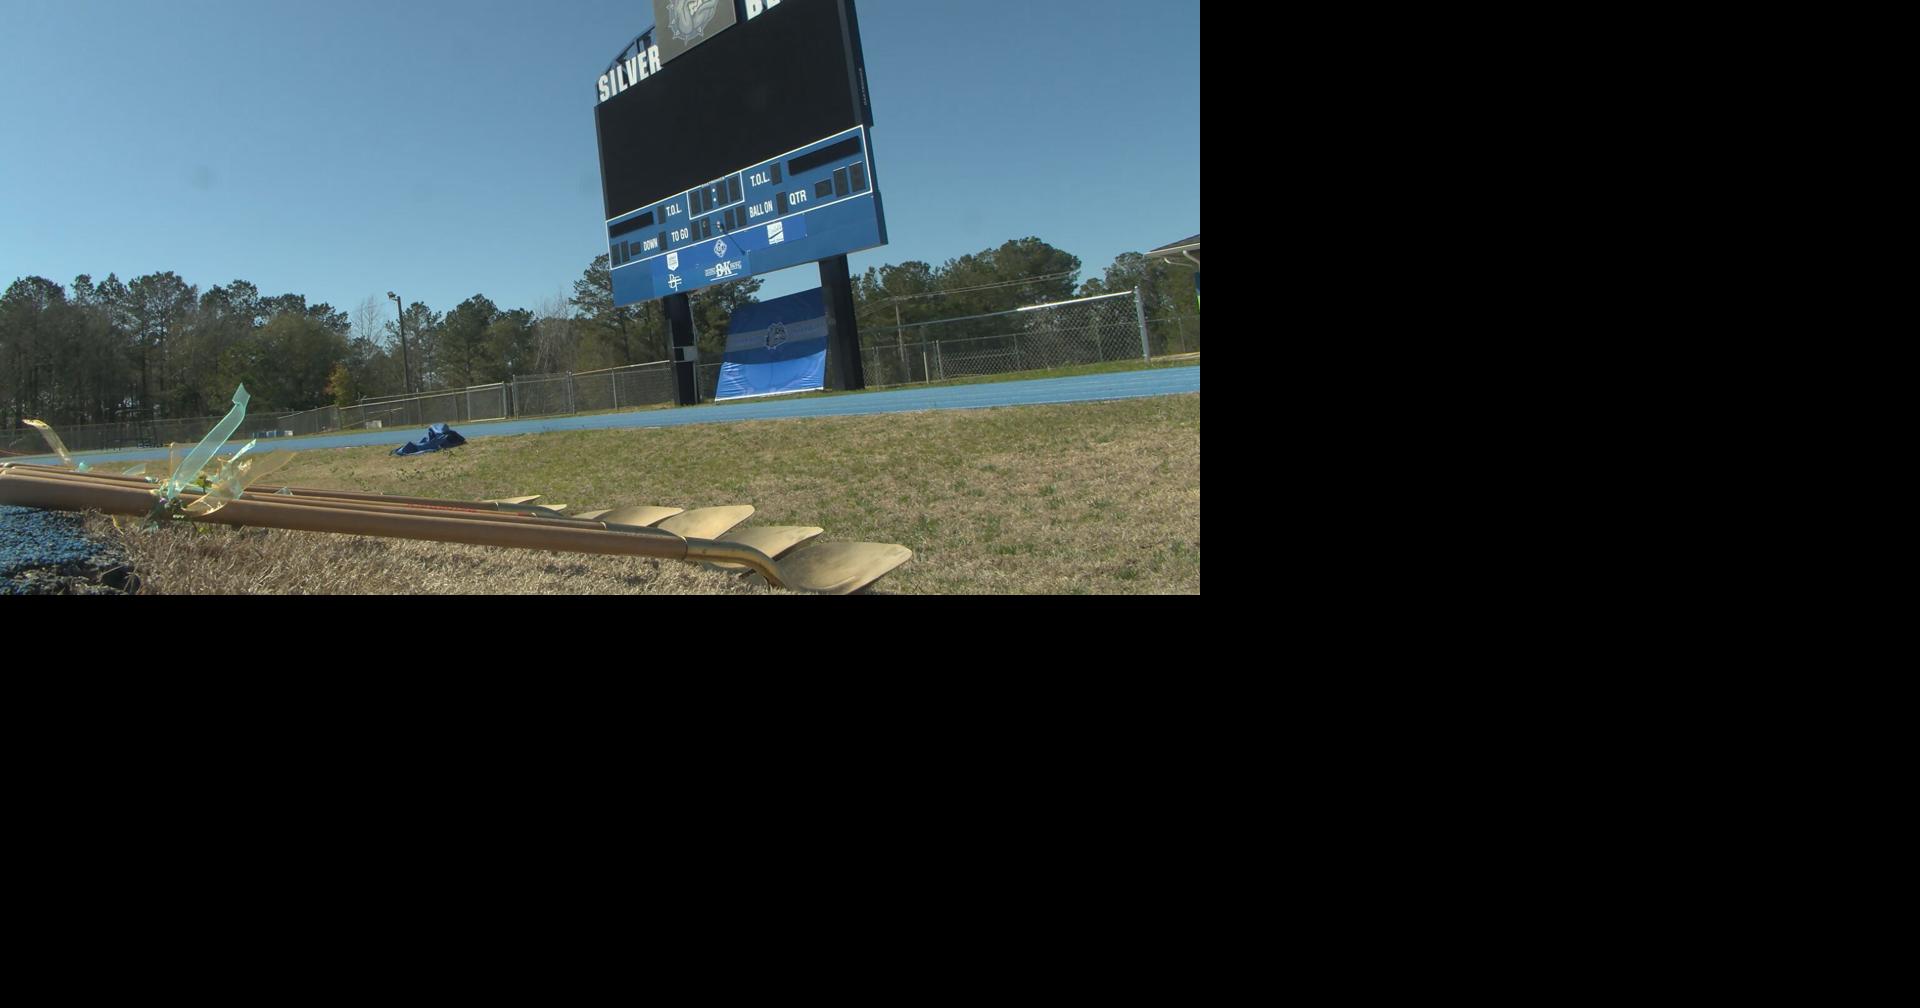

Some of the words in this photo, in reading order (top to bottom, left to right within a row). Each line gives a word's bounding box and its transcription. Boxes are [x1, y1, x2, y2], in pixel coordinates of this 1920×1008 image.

[598, 45, 662, 102] SILVER
[750, 172, 770, 187] T.O.L.
[789, 190, 807, 206] QTR
[666, 203, 682, 217] T.O.L.
[749, 203, 763, 218] BALL
[764, 200, 773, 214] ON
[671, 231, 680, 242] TO
[680, 228, 689, 240] GO
[643, 237, 658, 251] DOWN
